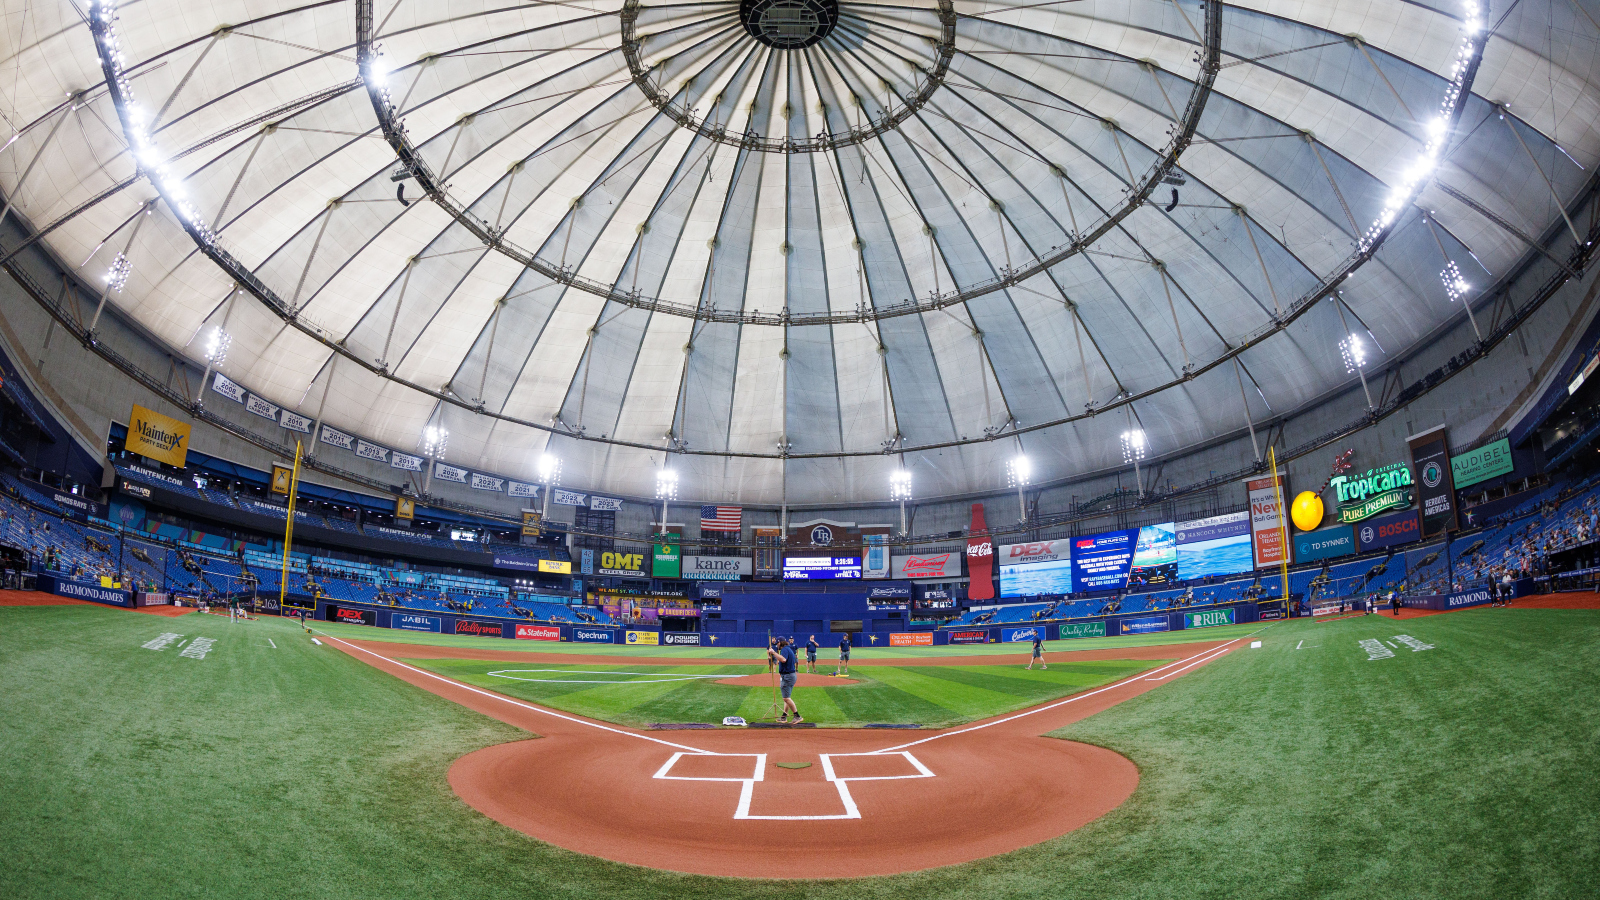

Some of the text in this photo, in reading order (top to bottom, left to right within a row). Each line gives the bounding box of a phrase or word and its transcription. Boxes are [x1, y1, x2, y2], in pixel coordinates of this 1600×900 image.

[216, 386, 238, 400] CHAMPIONS
[221, 382, 236, 394] 2008
[248, 406, 272, 418] CHAMPIONS
[254, 402, 270, 412] 2008
[282, 422, 306, 432] CHAMPIONS
[288, 418, 302, 426] 2010
[134, 419, 184, 451] MaintenX
[324, 436, 335, 444] WILD
[330, 432, 344, 442] 2011
[140, 436, 169, 451] PARTY DECK
[364, 446, 380, 456] 2013
[398, 458, 414, 466] 2019
[1454, 446, 1510, 472] AUDIBEL
[1376, 461, 1405, 474] ORIGINAL
[1461, 458, 1504, 476] HEARING CENTERS
[130, 464, 182, 486] MAINTENX.COM
[438, 473, 462, 482] CHAMPIONS
[478, 478, 496, 486] 2020
[1331, 467, 1410, 502] Tropicana
[1343, 492, 1403, 521] PURE PREMIUM
[1425, 495, 1447, 508] REROUTE
[120, 508, 134, 520] VIVA
[1252, 502, 1282, 515] New
[1425, 503, 1450, 516] AMERICAS
[1188, 524, 1246, 538] HANCOCK WHITNEY
[1379, 519, 1418, 538] BOSCH
[815, 529, 828, 542] TB
[1076, 539, 1094, 547] DEX
[1322, 537, 1349, 548] SYNNEX
[1010, 542, 1054, 557] DEX
[602, 552, 643, 570] GMF
[695, 557, 740, 570] kane's
[907, 559, 945, 568] Budweiser
[1020, 554, 1058, 562] imaging
[60, 582, 124, 603] RAYMOND JAMES
[1450, 591, 1487, 606] RAYMOND
[265, 599, 276, 608] 162
[337, 608, 364, 620] DEX
[402, 616, 430, 624] JABIL
[1203, 612, 1228, 626] RIPA
[456, 620, 481, 635] Bally
[1062, 626, 1082, 636] Quality
[578, 631, 608, 640] Spectrum
